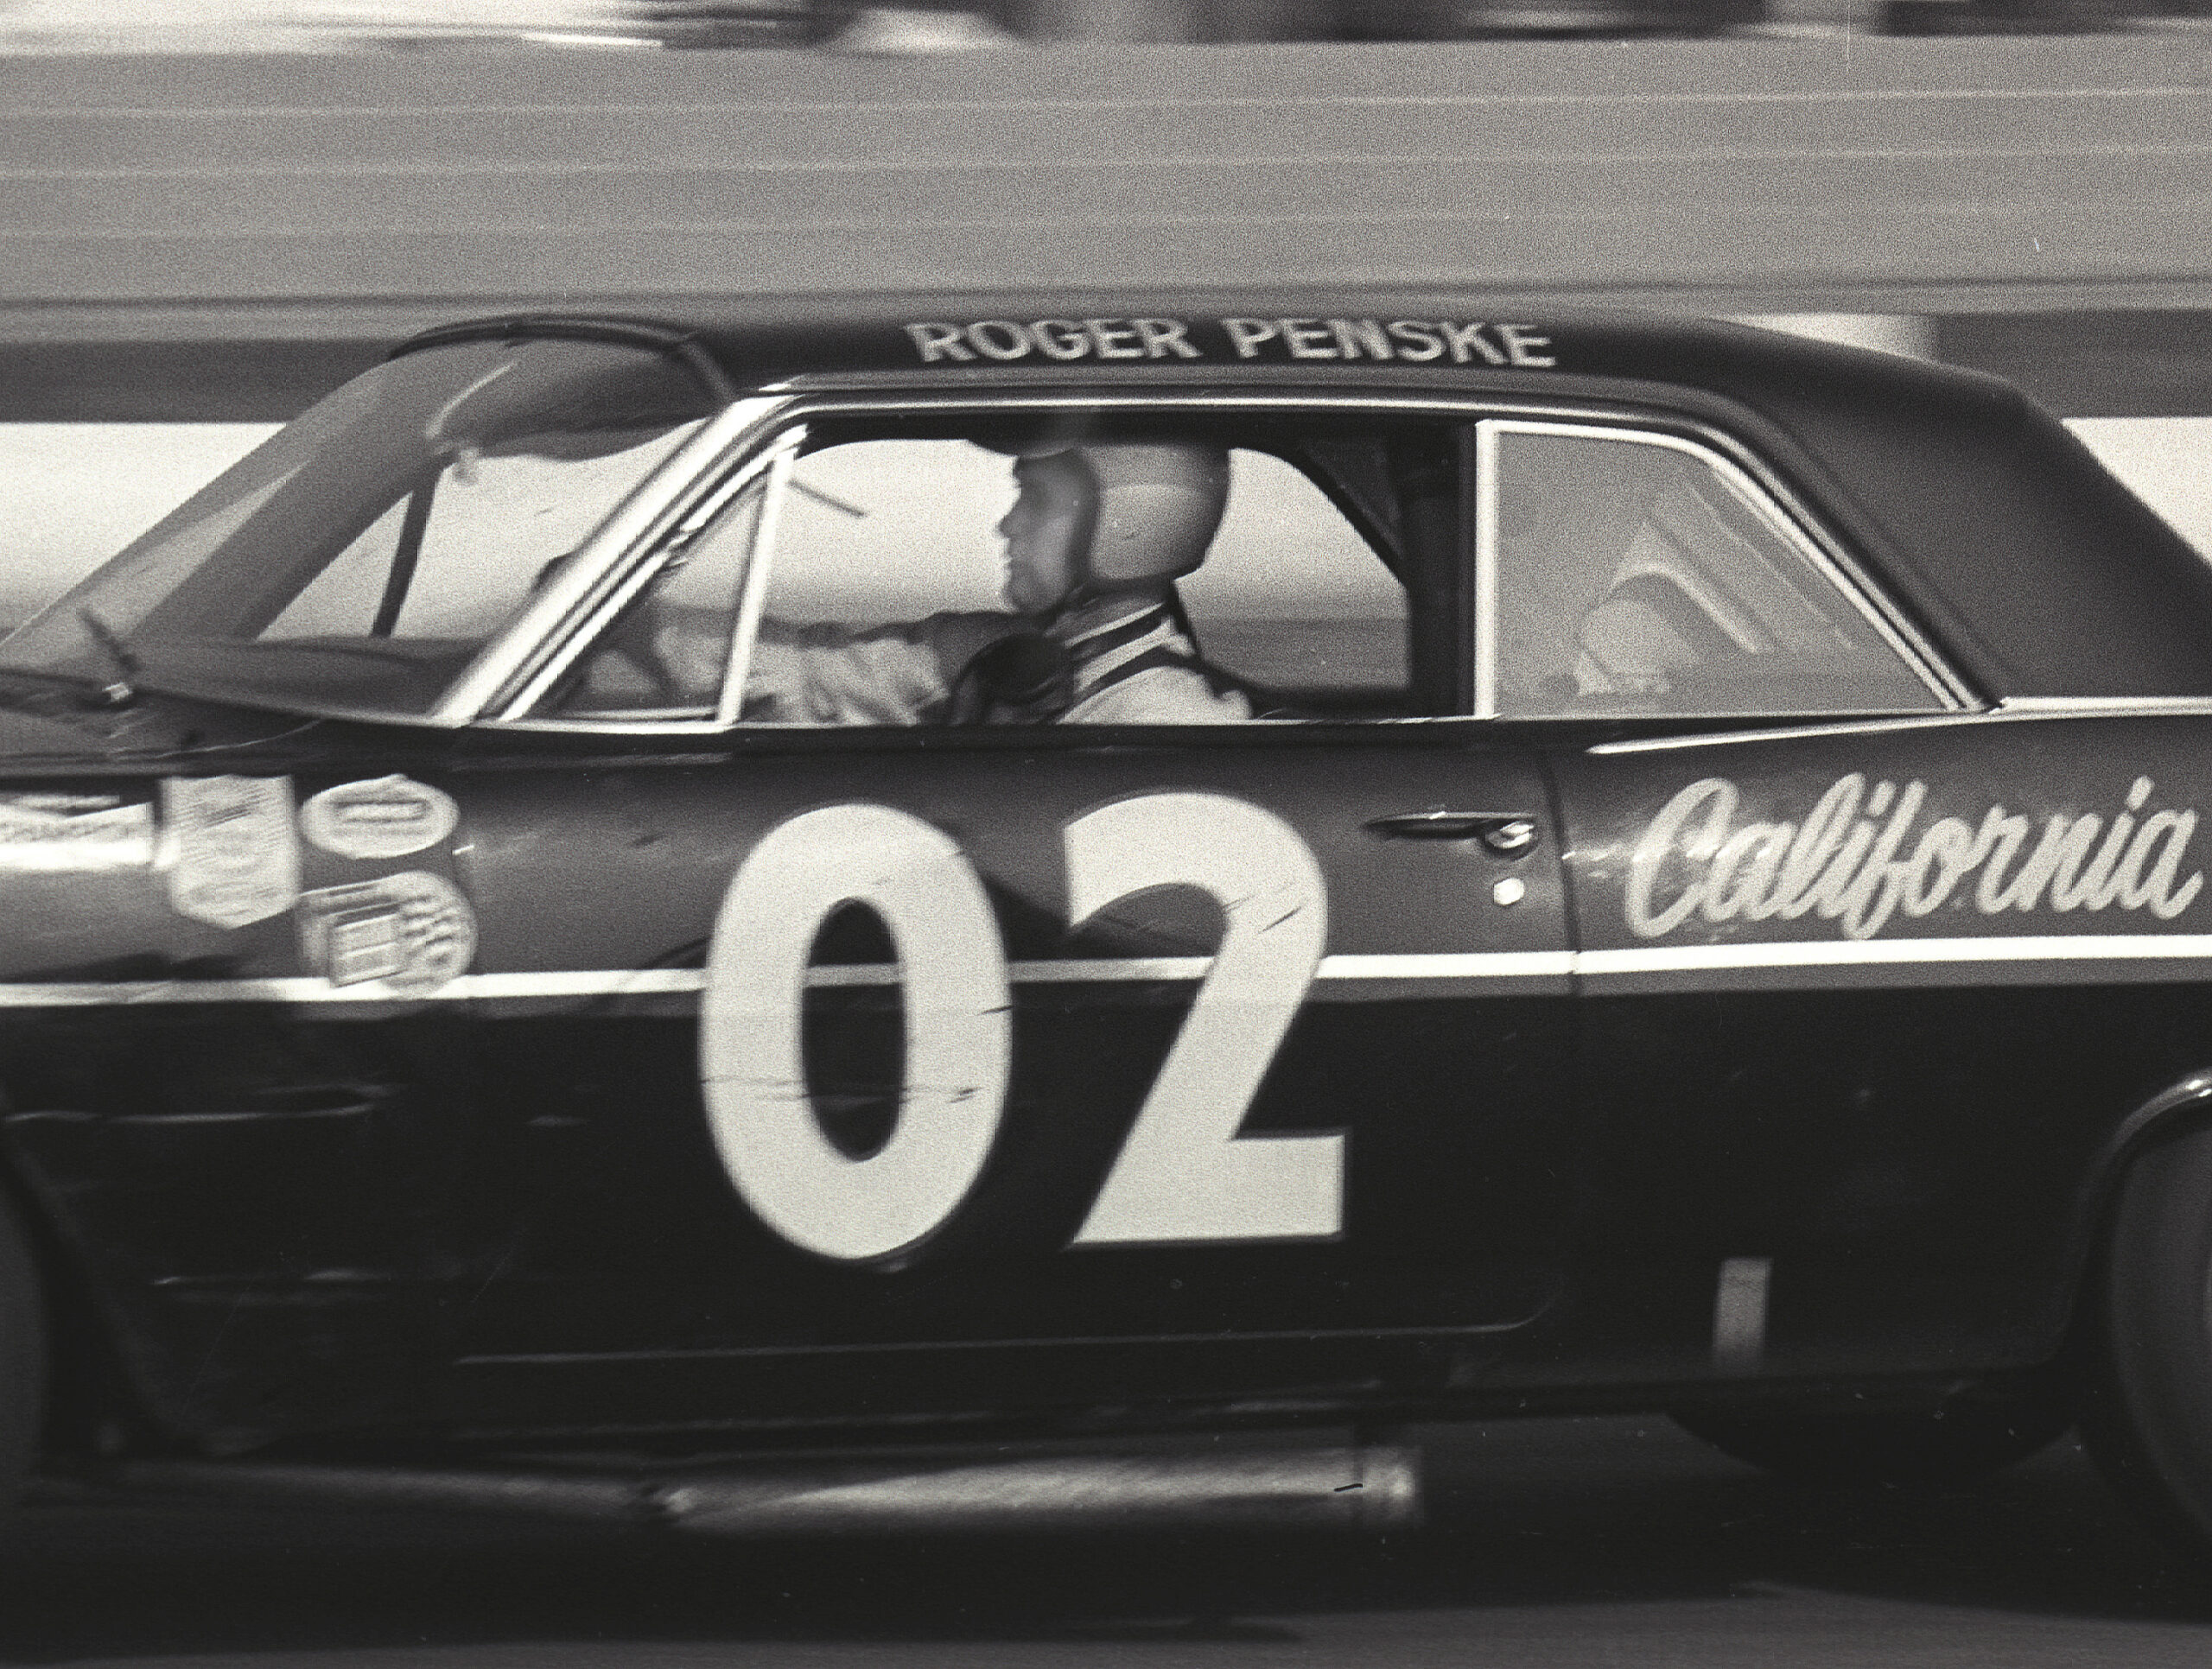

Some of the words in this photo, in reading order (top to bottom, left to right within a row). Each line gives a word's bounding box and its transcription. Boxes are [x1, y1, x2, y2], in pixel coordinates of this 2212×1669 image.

[903, 317, 1202, 363] ROGER
[1222, 317, 1556, 368] PENSKE
[1625, 772, 2205, 941] California
[700, 791, 1346, 1260] 02
